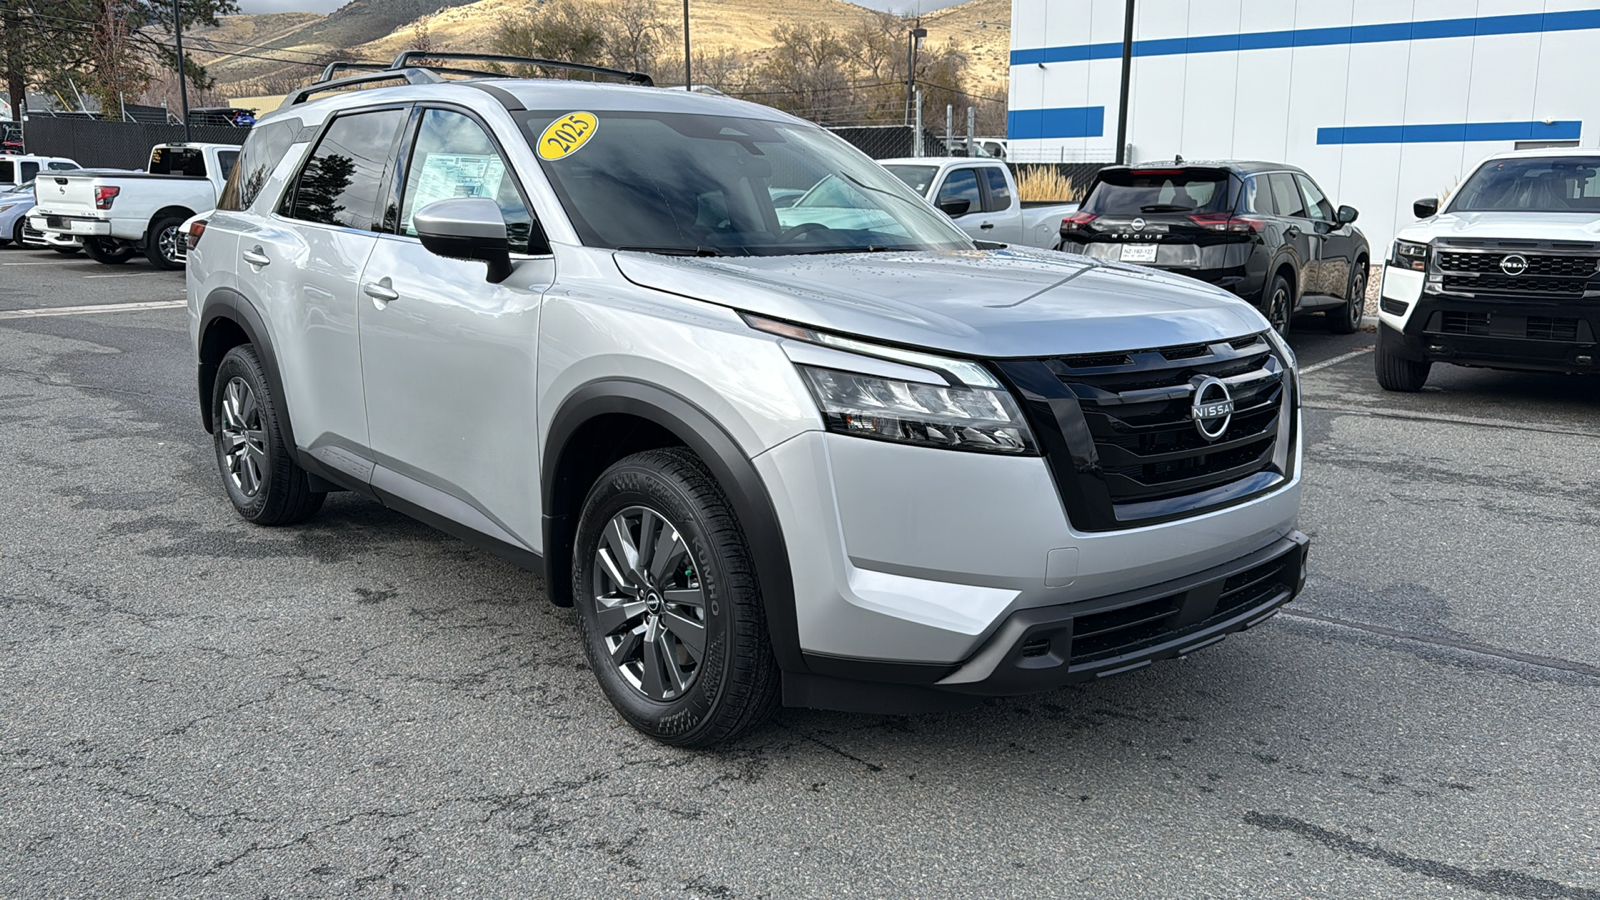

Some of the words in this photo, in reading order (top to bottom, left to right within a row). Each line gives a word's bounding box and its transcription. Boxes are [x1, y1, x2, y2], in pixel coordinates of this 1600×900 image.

[547, 115, 589, 153] 2025
[1499, 261, 1529, 269] NISSAN
[1193, 403, 1234, 418] NISSAN
[692, 536, 719, 616] KUMHO
